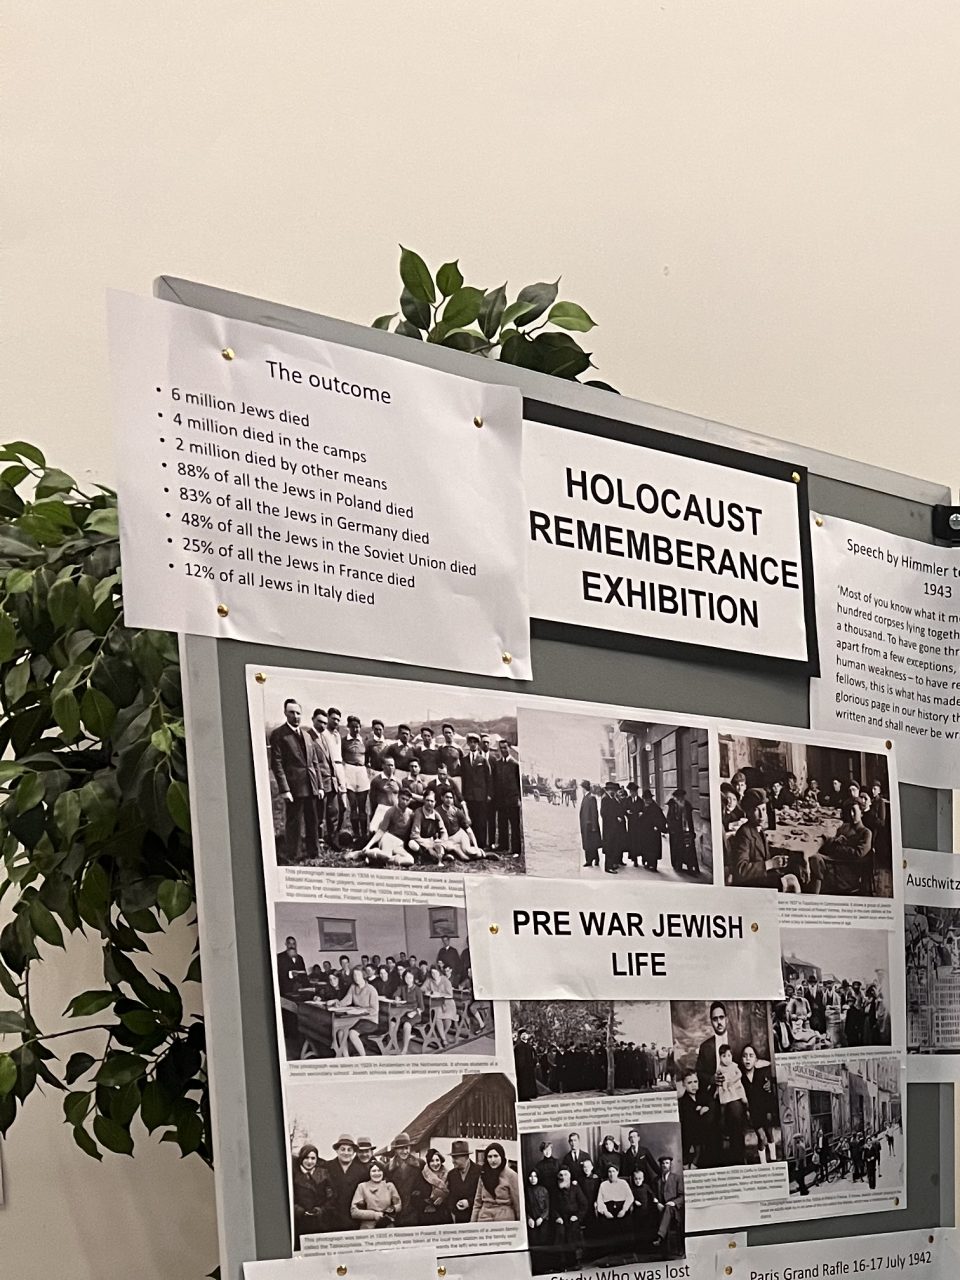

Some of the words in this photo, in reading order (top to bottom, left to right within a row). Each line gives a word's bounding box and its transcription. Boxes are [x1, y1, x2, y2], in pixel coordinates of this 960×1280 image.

[265, 359, 302, 384] The
[308, 374, 391, 404] outcome
[171, 387, 180, 401] 6
[185, 392, 235, 412] million
[239, 401, 274, 420] Jews
[279, 409, 309, 427] died
[173, 412, 182, 426] 4
[187, 417, 237, 437] million
[242, 426, 274, 443] died
[278, 432, 291, 447] in
[295, 436, 318, 453] the
[323, 445, 367, 465] camps
[175, 437, 184, 451] 2
[189, 442, 240, 461] million
[244, 450, 276, 468] died
[280, 456, 297, 475] by
[301, 463, 339, 480] other
[343, 473, 387, 490] means
[177, 462, 209, 480] 88%
[214, 469, 229, 483] of
[233, 472, 249, 487] all
[254, 476, 278, 492] the
[282, 481, 315, 499] Jews
[319, 488, 331, 503] in
[336, 491, 381, 512] Poland
[385, 501, 413, 518] died
[565, 466, 763, 536] HOLOCAUST
[181, 512, 213, 529] 48%
[217, 518, 232, 533] of
[236, 522, 252, 537] all
[257, 525, 281, 541] the
[284, 530, 318, 548] Jews
[322, 536, 334, 551] in
[338, 540, 360, 555] the
[364, 544, 404, 563] Soviet
[408, 552, 446, 570] Union
[450, 560, 476, 576] died
[529, 509, 800, 589] REMEMBERANCE
[847, 538, 884, 560] Speech
[886, 549, 898, 567] by
[901, 555, 949, 577] Himmler
[184, 562, 214, 580] 12%
[219, 568, 234, 582] of
[238, 571, 254, 586] all
[258, 574, 292, 592] Jews
[297, 579, 309, 594] in
[314, 583, 342, 602] Italy
[346, 588, 374, 605] died
[581, 570, 759, 629] EXHIBITION
[923, 582, 952, 598] 1943
[863, 593, 872, 603] of
[873, 597, 888, 610] you
[890, 599, 912, 615] know
[914, 607, 935, 621] what
[938, 610, 945, 622] it
[512, 910, 571, 936] PRE
[579, 912, 646, 937] WAR
[651, 913, 744, 939] JEWISH
[611, 952, 667, 976] LIFE
[634, 1268, 662, 1280] was
[665, 1264, 691, 1279] lost
[783, 1263, 818, 1280] Grand
[822, 1260, 849, 1276] Rafle
[853, 1256, 883, 1272] 16-17
[885, 1254, 905, 1270] July
[908, 1250, 931, 1266] 1942
